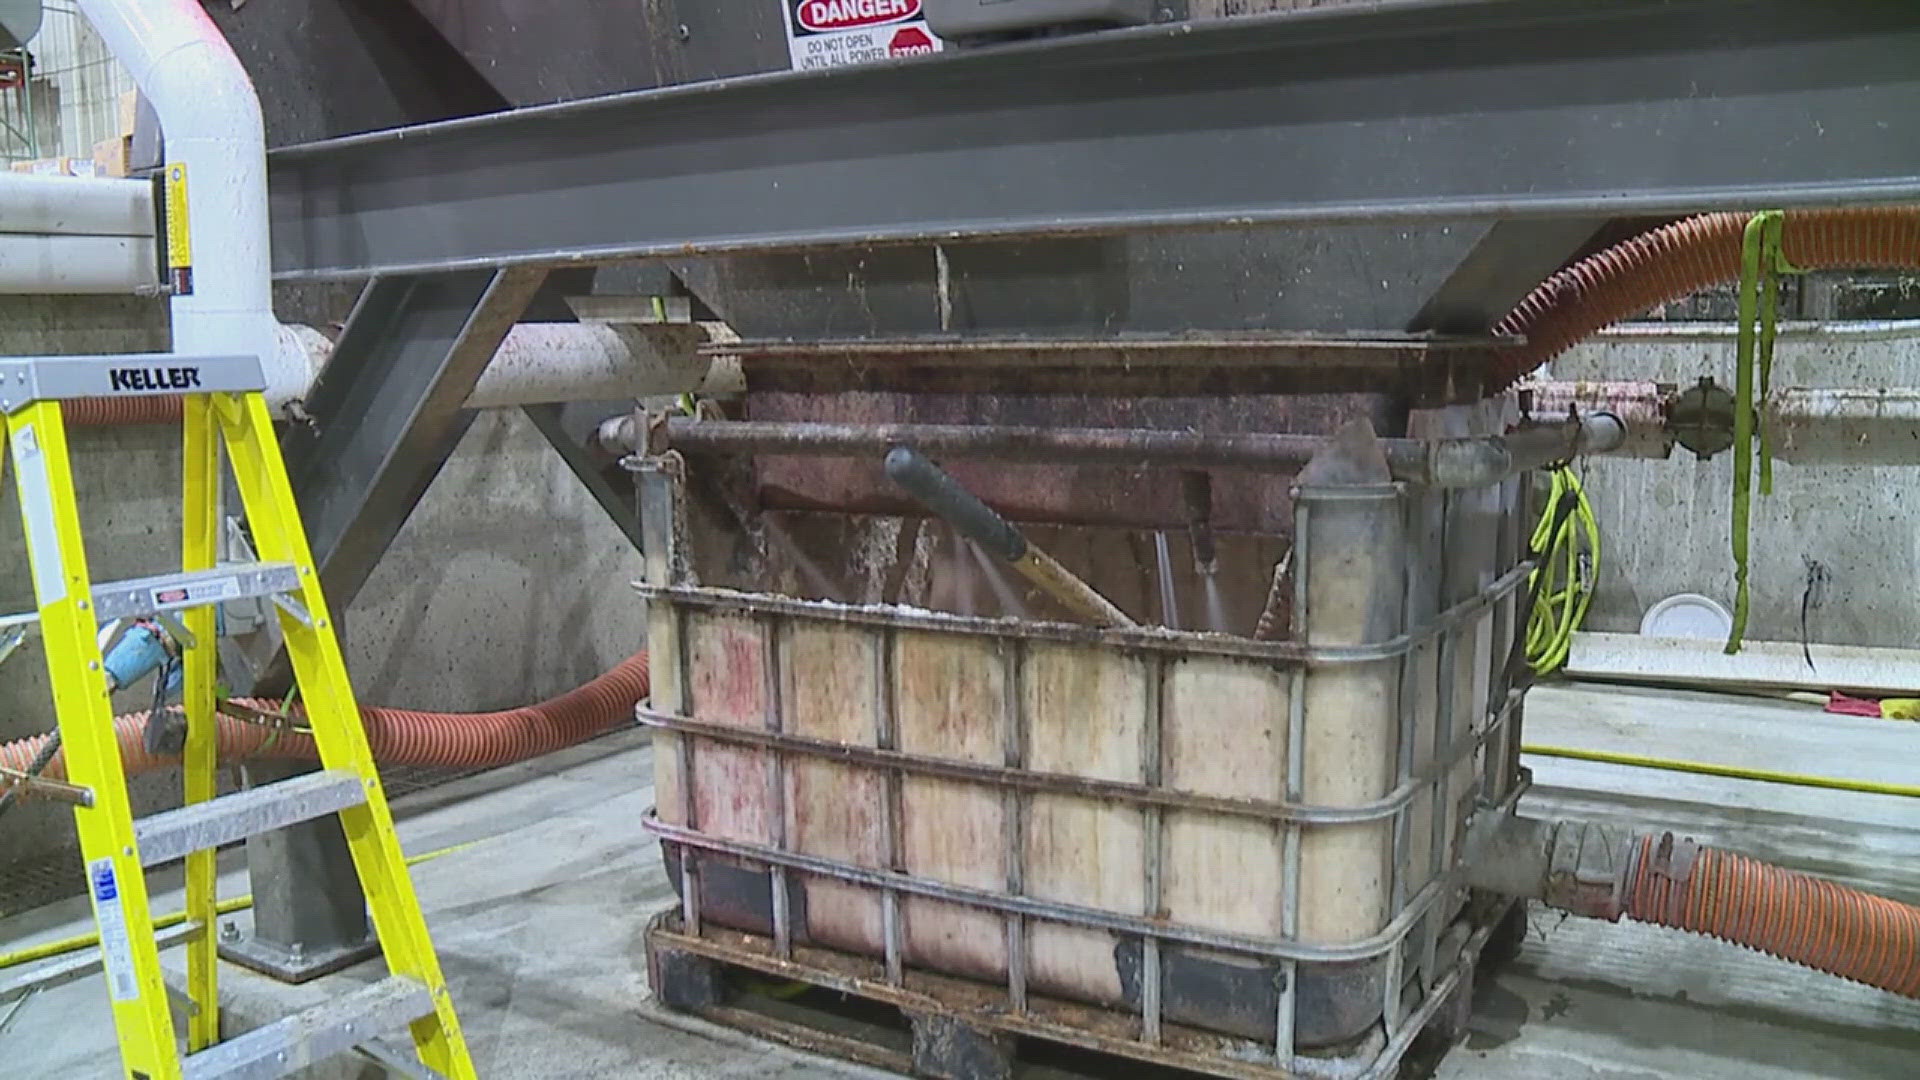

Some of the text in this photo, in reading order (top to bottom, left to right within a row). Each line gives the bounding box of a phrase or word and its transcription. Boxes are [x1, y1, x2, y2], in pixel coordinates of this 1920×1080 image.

[810, 0, 908, 25] DANGER
[807, 34, 873, 54] DO NOT OPEN
[800, 47, 885, 70] UNTIL ALL POWER
[109, 367, 201, 391] KELLER
